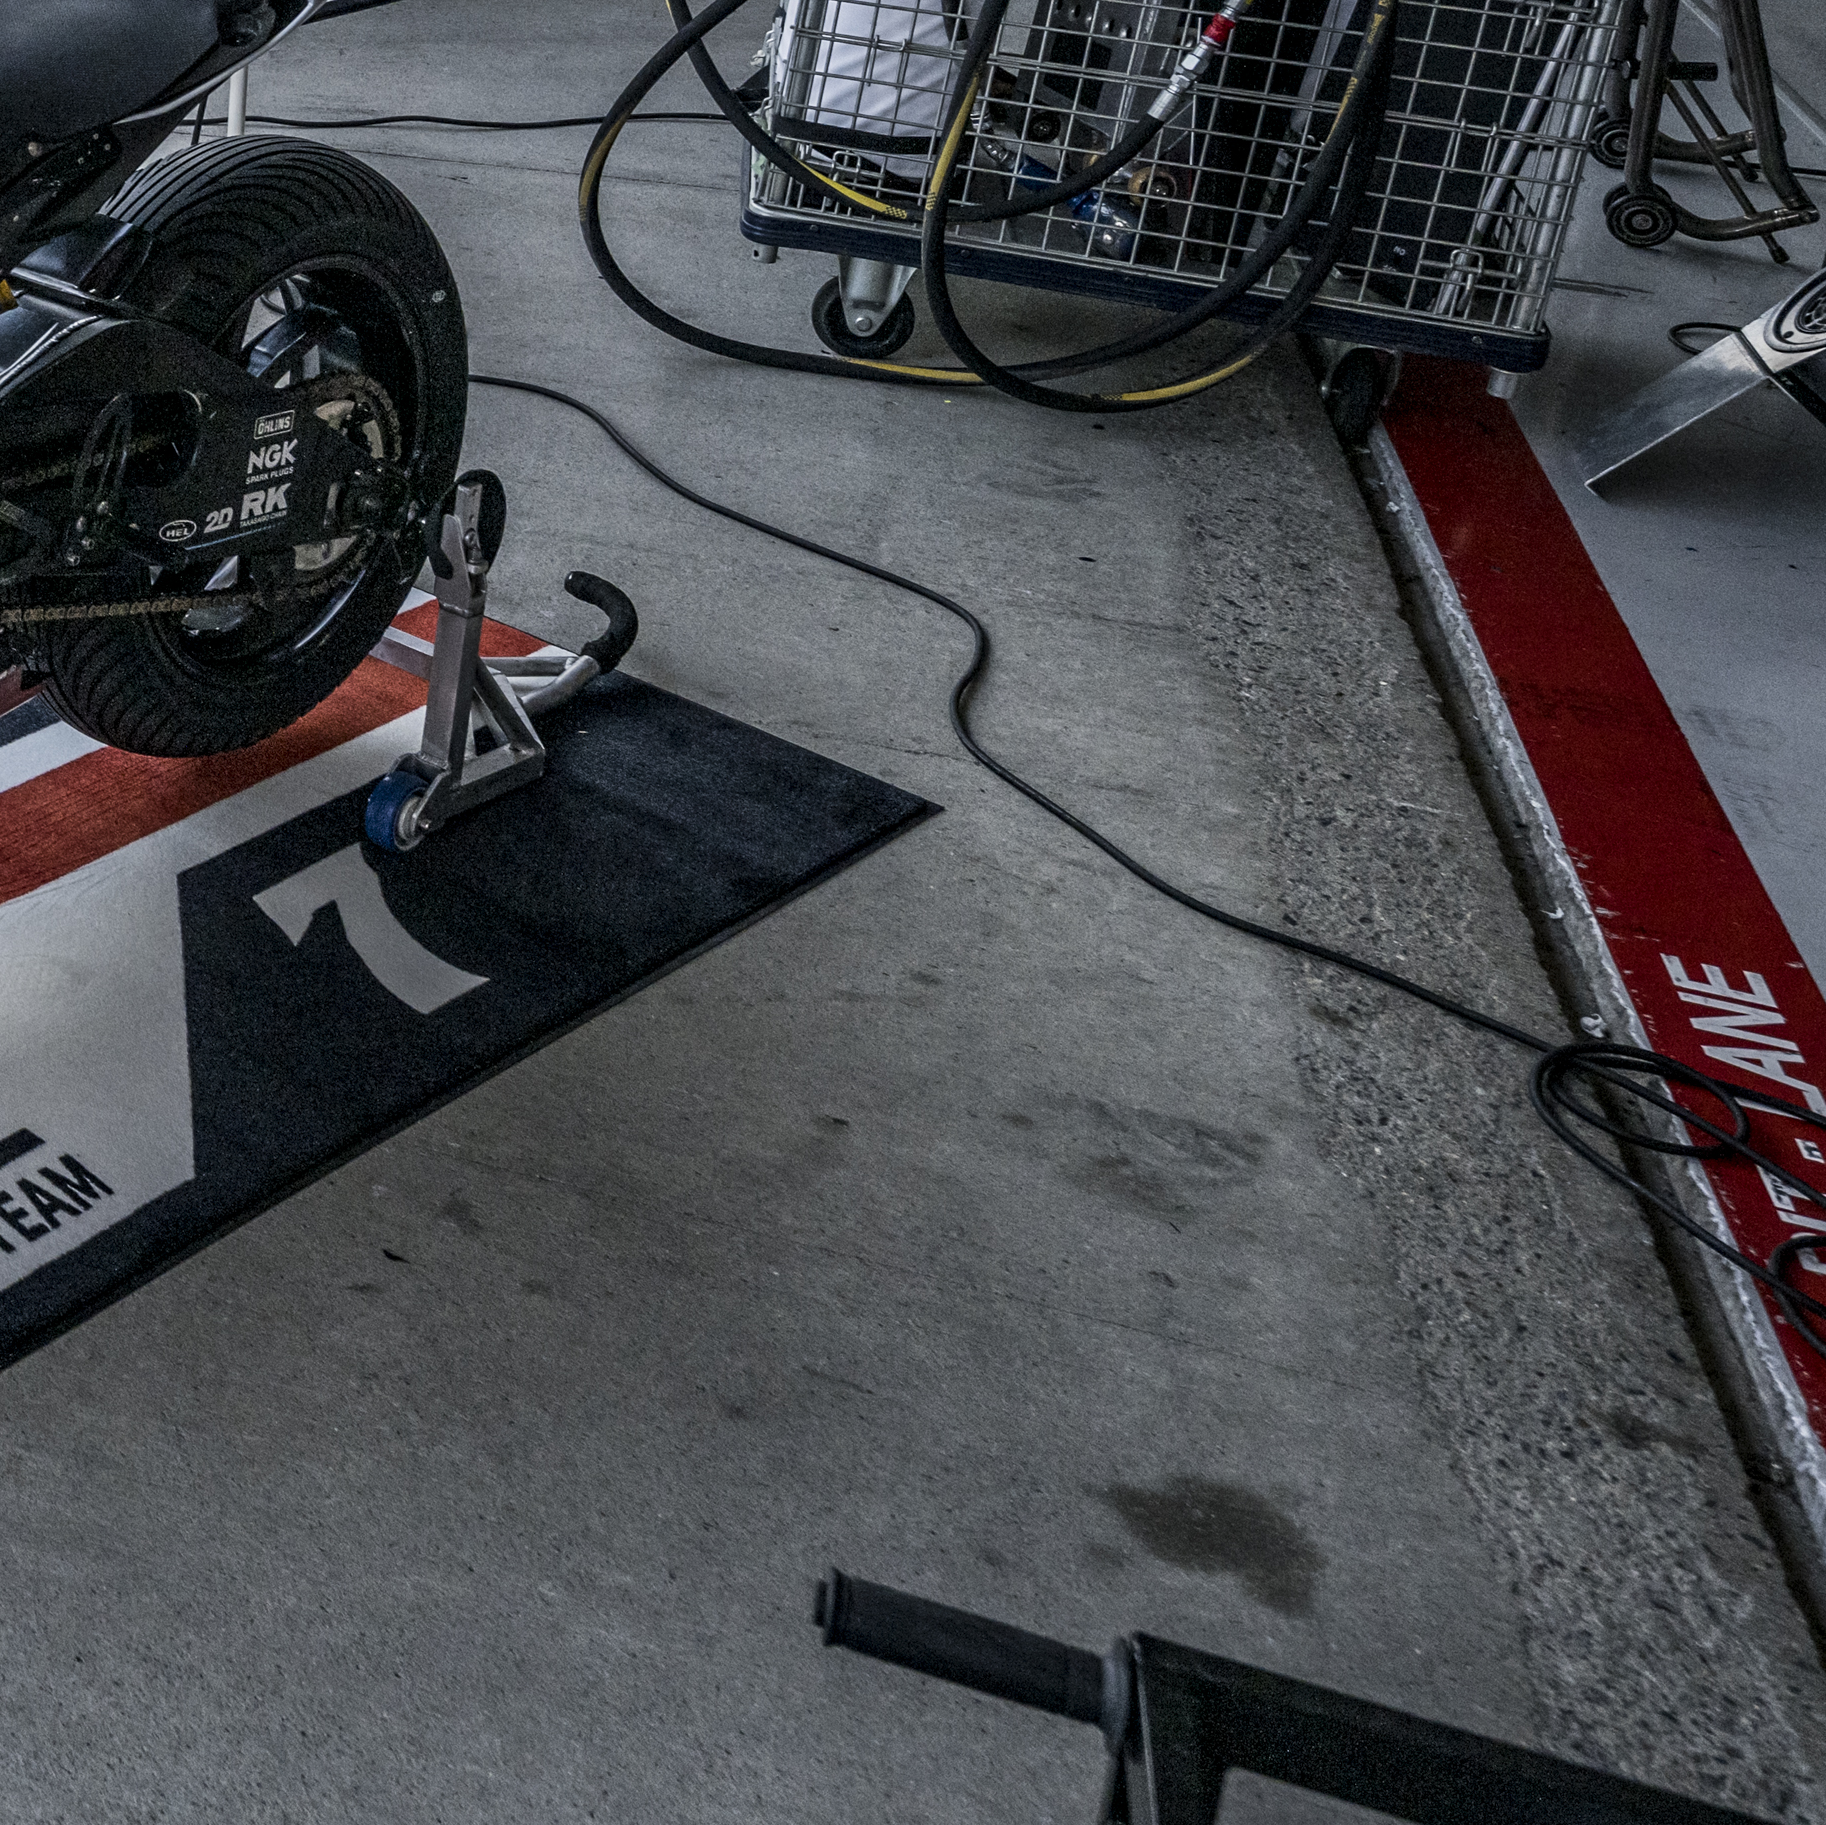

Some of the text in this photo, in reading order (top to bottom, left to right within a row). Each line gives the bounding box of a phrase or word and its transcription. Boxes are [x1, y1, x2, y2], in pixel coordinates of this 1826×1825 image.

[257, 414, 291, 433] ÖHLINS
[247, 438, 298, 473] NGK
[245, 467, 294, 486] SPARK PLUGS
[240, 483, 291, 521] RK
[165, 526, 190, 538] HEL
[203, 507, 234, 534] 2D
[253, 884, 491, 1016] 7
